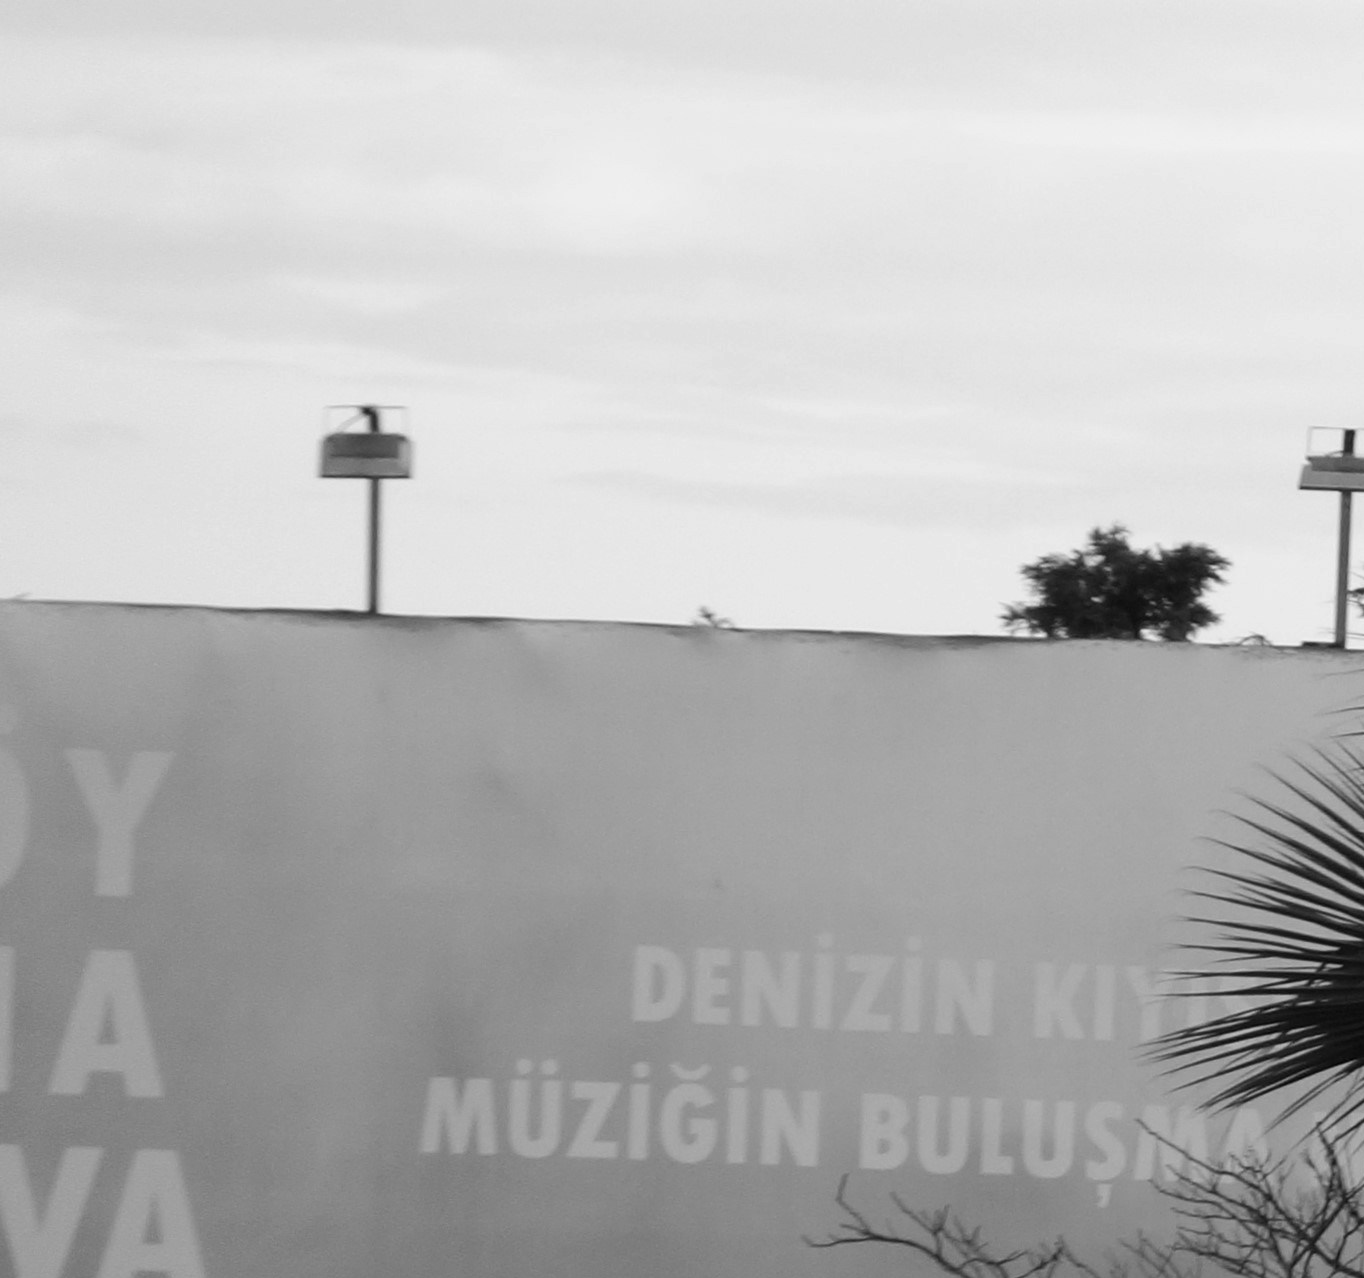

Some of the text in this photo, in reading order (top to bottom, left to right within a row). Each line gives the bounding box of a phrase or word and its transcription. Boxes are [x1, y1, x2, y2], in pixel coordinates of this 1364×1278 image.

[0, 711, 176, 897] Y
[631, 932, 994, 1037] DENİZİN
[419, 1057, 820, 1168] MÜZİĞİN
[858, 1092, 1272, 1208] BULUŞMA
